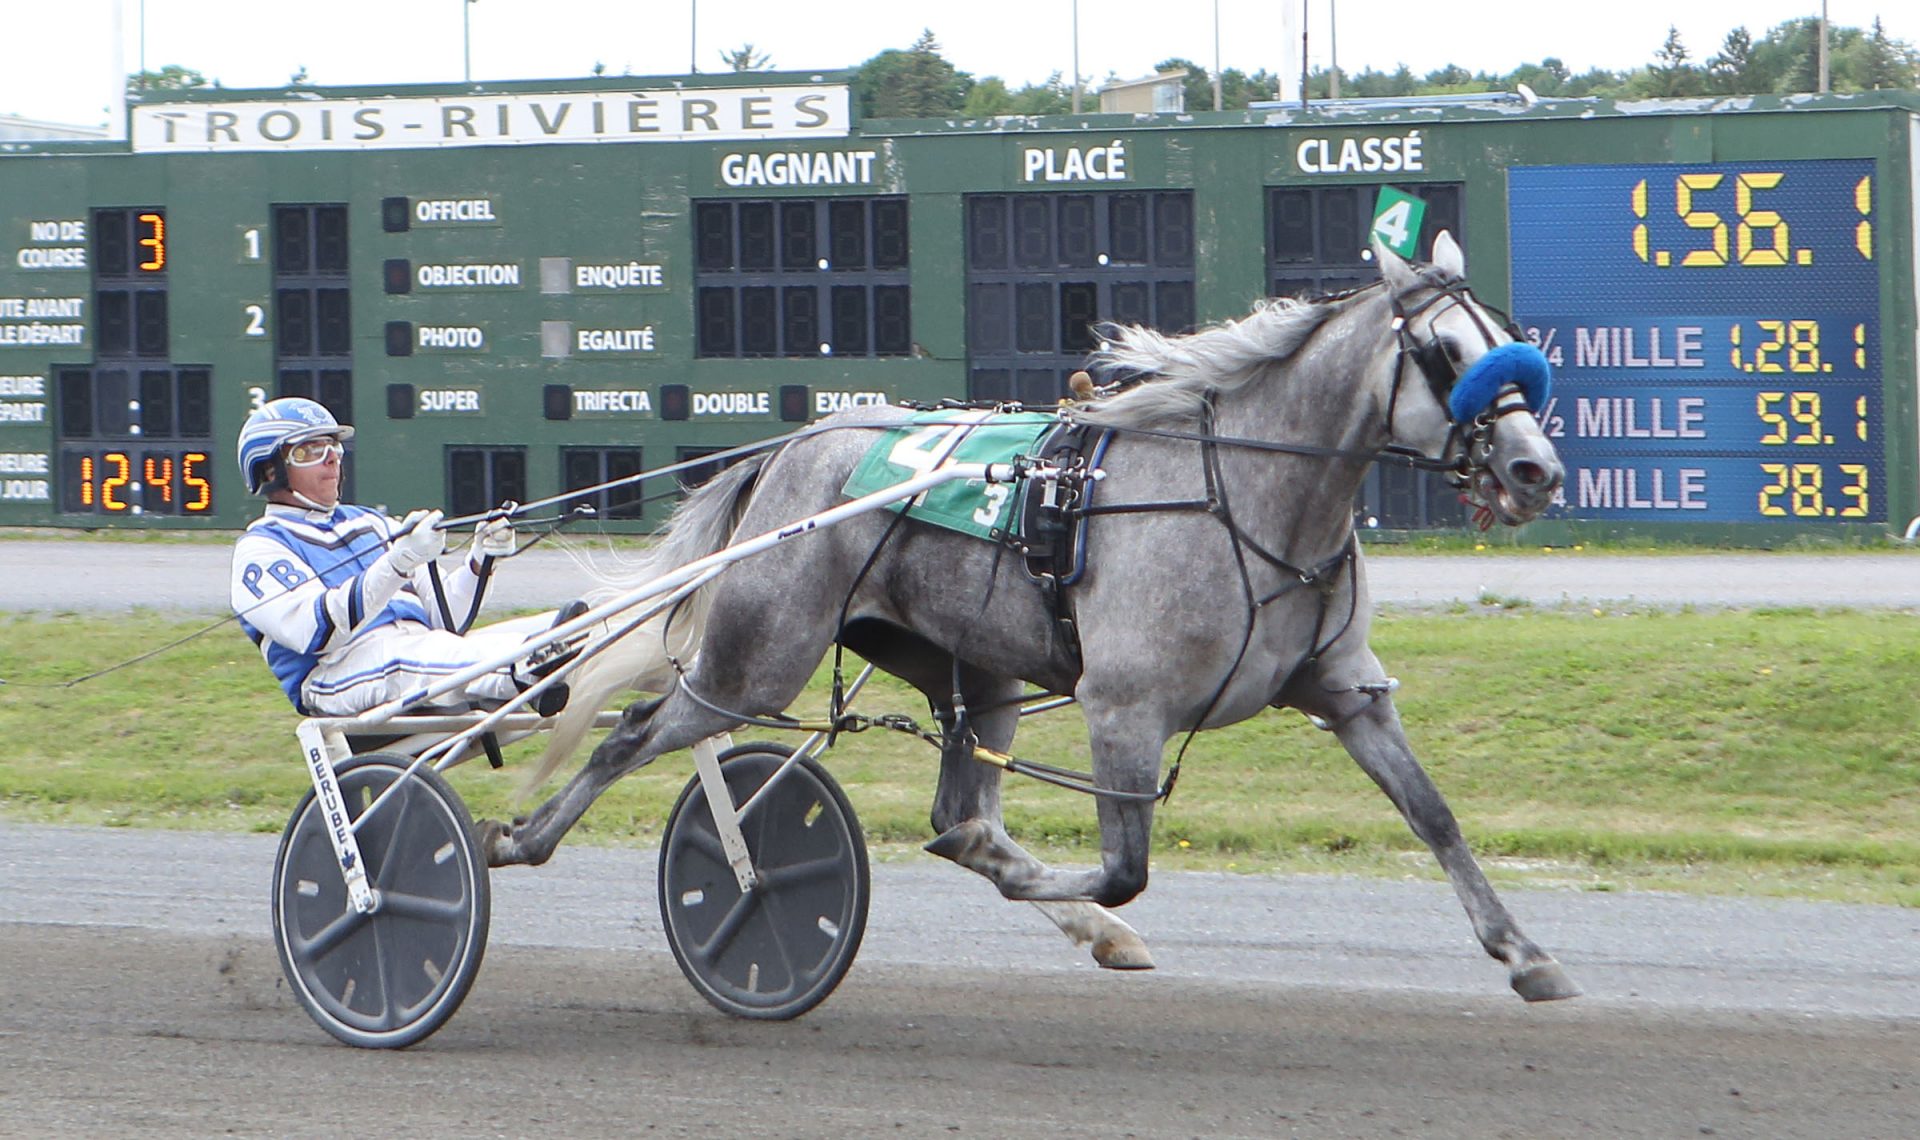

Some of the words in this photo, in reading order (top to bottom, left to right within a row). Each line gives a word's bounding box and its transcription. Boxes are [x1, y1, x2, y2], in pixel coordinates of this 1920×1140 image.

[152, 93, 828, 143] TROIS-RIVIÈRES
[1025, 140, 1125, 181] PLACÉ
[1297, 130, 1422, 173] CLASSÉ
[721, 152, 876, 185] GAGNANT
[416, 200, 495, 221] OFFICIEL
[31, 222, 58, 240] NO
[60, 222, 84, 240] DE
[1374, 201, 1412, 248] 4
[140, 215, 163, 269] 3
[245, 230, 258, 258] 1
[17, 248, 85, 268] COURSE
[418, 265, 518, 285] OBJECTION
[577, 262, 662, 288] ENQUÊTE
[26, 298, 83, 317] AVANT
[246, 306, 264, 334] 2
[18, 321, 84, 343] DÉPART
[419, 328, 482, 347] PHOTO
[579, 326, 653, 350] EGALITÉ
[1577, 328, 1703, 366] MILLE
[248, 387, 267, 414] 3
[421, 391, 478, 410] SUPER
[574, 391, 650, 411] TRIFECTA
[693, 393, 769, 413] DOUBLE
[815, 392, 888, 412] EXACTA
[1579, 399, 1704, 437] MILLE
[3, 479, 49, 499] JOUR
[1580, 469, 1706, 508] MILLE
[1760, 464, 1867, 516] 28.3
[972, 484, 1009, 526] 3
[309, 747, 348, 845] BERUBE
